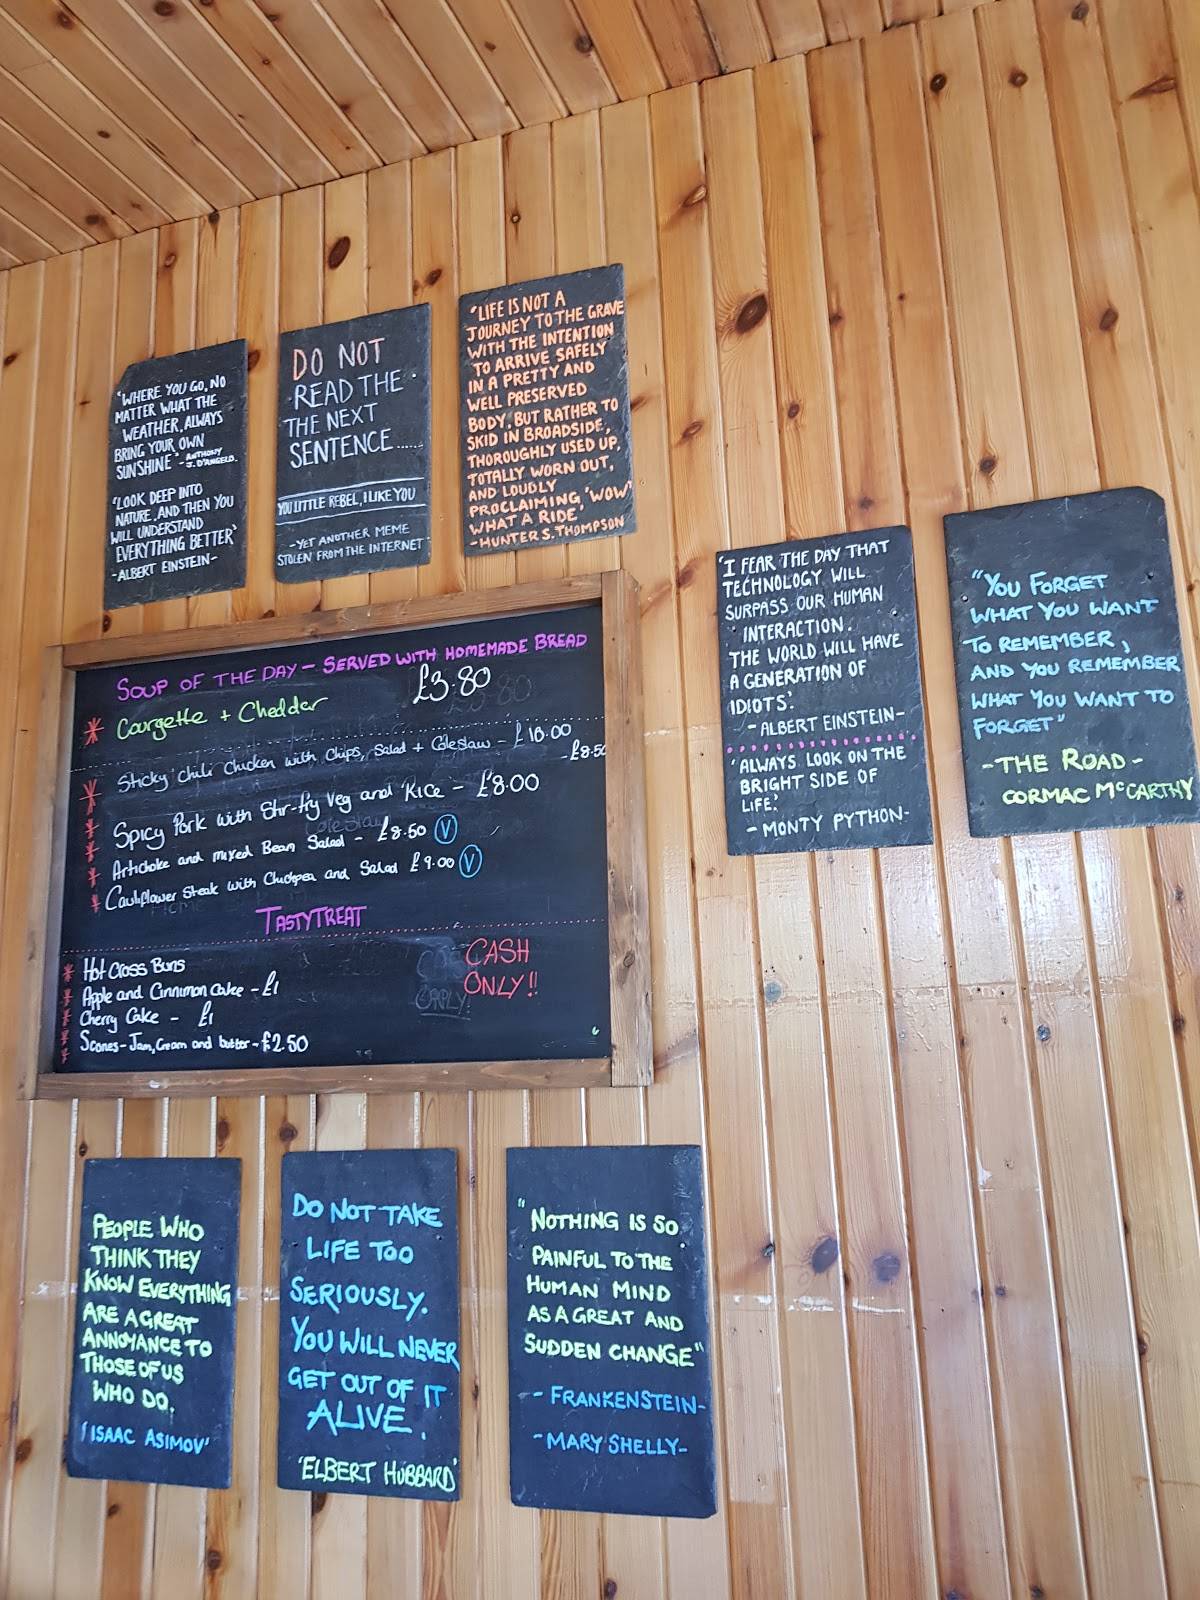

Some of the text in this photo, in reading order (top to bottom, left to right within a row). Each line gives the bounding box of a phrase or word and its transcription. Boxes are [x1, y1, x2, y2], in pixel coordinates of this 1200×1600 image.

[522, 292, 550, 313] NOT
[466, 300, 624, 342] JOURNEY GRAVE
[339, 338, 385, 369] NOT
[468, 322, 614, 359] WITH THE INTENTION
[495, 340, 607, 371] ARRIVE SAFELY
[503, 361, 595, 388] PRETTY AND
[294, 370, 403, 410] READ THE
[467, 382, 587, 412] WELL PRESERVED
[115, 401, 191, 424] MATTER WHAT
[184, 411, 223, 431] ALWAYS
[284, 403, 378, 438] THE NEXT
[514, 404, 597, 428] BUT RATHER
[114, 433, 205, 462] BRING YOUR OWN
[467, 433, 499, 451] SKID
[468, 436, 595, 468] THOROUGHLY USED
[468, 460, 575, 486] TOTALLY WORN
[150, 483, 203, 504] DEEP INTO
[469, 480, 557, 501] AND LOUDLY
[157, 499, 210, 520] AND THEN
[110, 517, 204, 544] WILL UNDERSTAND
[318, 524, 410, 546] ANOTHER MEME
[469, 515, 517, 535] WHAT
[554, 516, 624, 537] THOMPSON
[116, 536, 186, 562] EVERYTHING
[317, 538, 424, 561] FROM INTERNET
[741, 540, 891, 575] FEAR THE DAY THAT
[723, 566, 865, 598] TECHNOLOGY WILL
[1029, 571, 1108, 595] FORGET
[725, 585, 884, 620] SURPASS OUR HUMAN
[970, 599, 1159, 624] WHAT YOU WANT
[729, 633, 903, 669] THE WORLD WILL HAVE
[116, 634, 588, 701] SOUP OF THE DAY SERVED WITH HOMEMADE BREAD
[743, 664, 842, 689] GENERATION
[970, 655, 1181, 681] AND YOU REMEMBER
[412, 663, 490, 705] £3.80
[972, 689, 1140, 709] WHAT YOU WANT
[760, 716, 818, 737] ALBERT
[117, 771, 168, 793] Sticky
[374, 744, 406, 756] Salad
[806, 746, 907, 768] LOOK THE
[1062, 748, 1126, 771] ROAD
[740, 771, 849, 795] BRIGHT SIDE
[1001, 787, 1091, 805] CORMAC
[113, 769, 540, 851] Spicy Pork with Veg and £8.00
[763, 814, 823, 838] MONTY
[112, 816, 426, 881] Artichoke and Bean Salad £8.50
[105, 884, 177, 912] Cauliflower
[227, 878, 256, 892] with
[324, 868, 350, 880] and
[360, 860, 398, 876] Salad
[465, 937, 530, 966] CASH
[83, 958, 106, 983] Hot
[152, 958, 186, 973] Buns
[82, 986, 143, 1011] Apple and
[79, 1010, 117, 1034] Cherry
[192, 1036, 212, 1049] and
[331, 1198, 443, 1228] NOT TAKE
[531, 1207, 619, 1232] NOTHING
[92, 1213, 204, 1241] PEOPLE WHO
[90, 1246, 201, 1274] THINK THEY
[306, 1236, 414, 1264] LIFE TOO
[532, 1246, 673, 1271] PAINFUL THE
[83, 1268, 231, 1306] KNOW EVERYTHING
[527, 1275, 671, 1302] HUMAN MIND
[83, 1302, 199, 1335] ARE GREAT
[572, 1307, 684, 1332] GREAT AND
[82, 1328, 182, 1356] ANNOYANCE
[291, 1316, 460, 1371] YOU WILL NEVER
[524, 1334, 601, 1360] SUDDEN
[80, 1351, 136, 1377] THOSE
[92, 1381, 134, 1404] WHO
[288, 1367, 382, 1394] GET OUT
